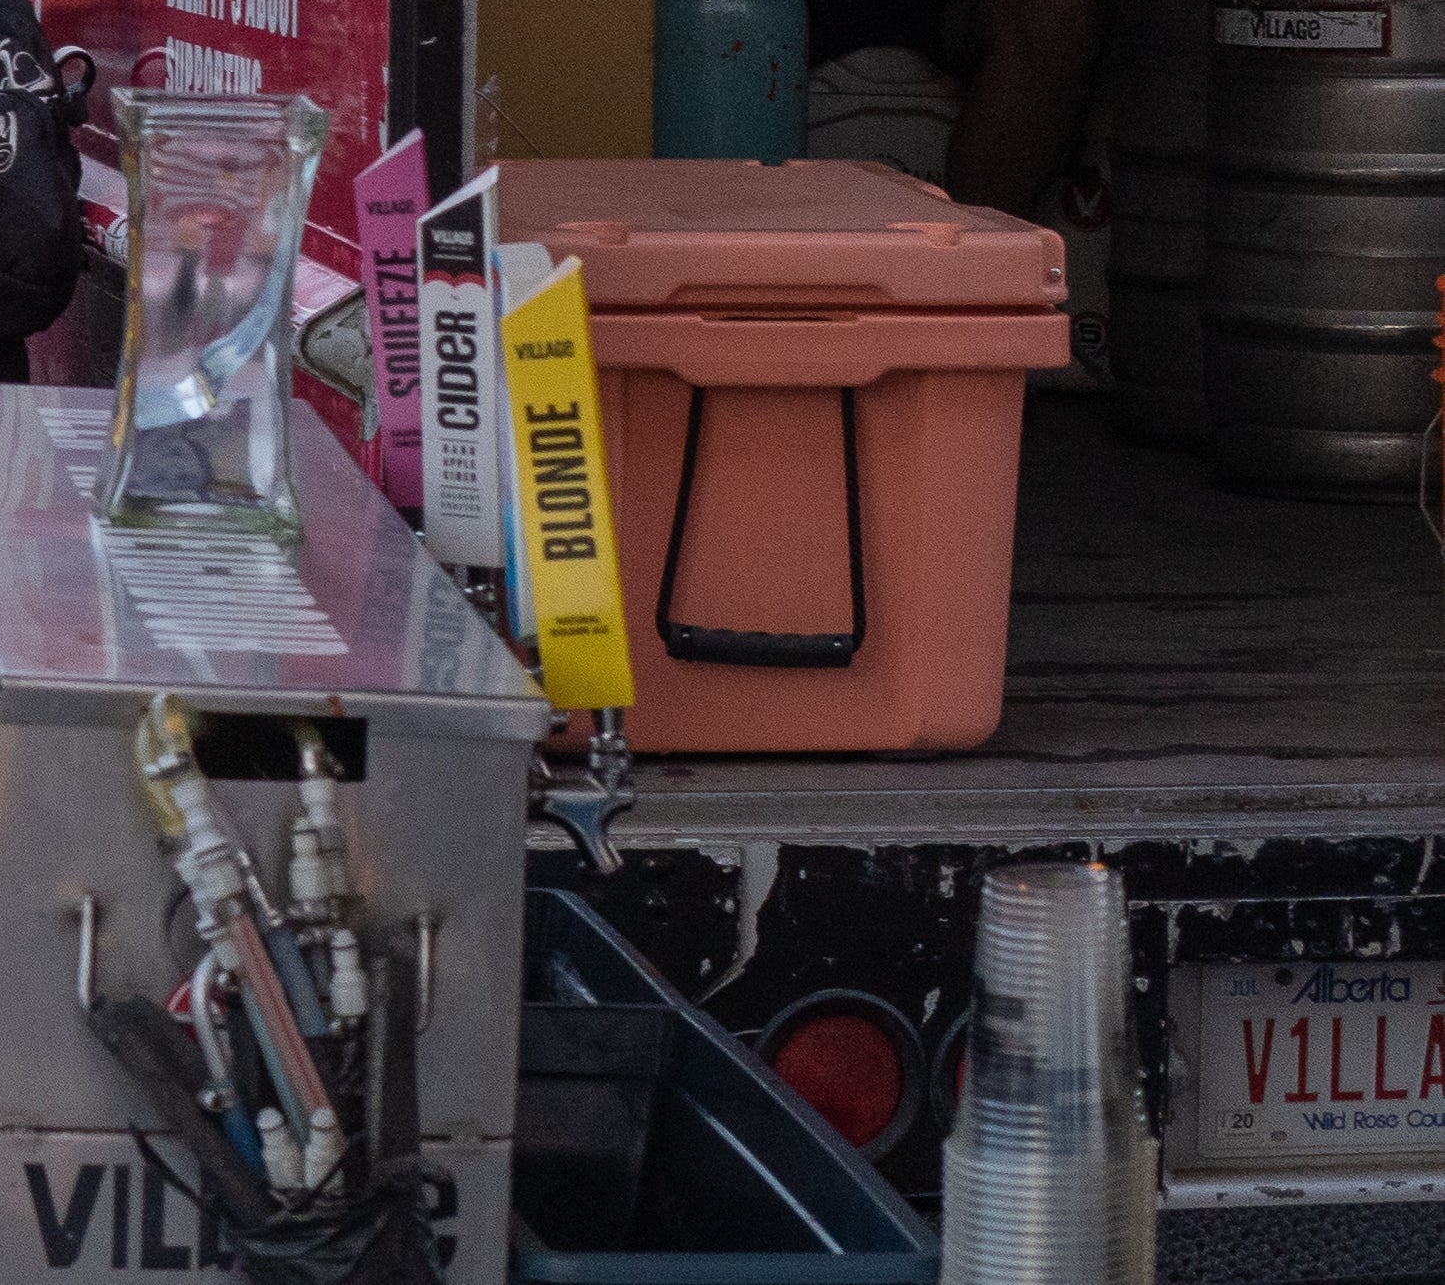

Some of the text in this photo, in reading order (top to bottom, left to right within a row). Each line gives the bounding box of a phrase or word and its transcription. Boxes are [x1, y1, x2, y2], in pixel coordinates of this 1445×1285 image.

[525, 401, 597, 561] BLONDE
[1291, 964, 1411, 1004] Alberta
[1232, 1113, 1254, 1129] 20
[1302, 1111, 1347, 1130] Wild
[1353, 1111, 1399, 1129] Rose
[23, 1163, 458, 1271] VILLE
